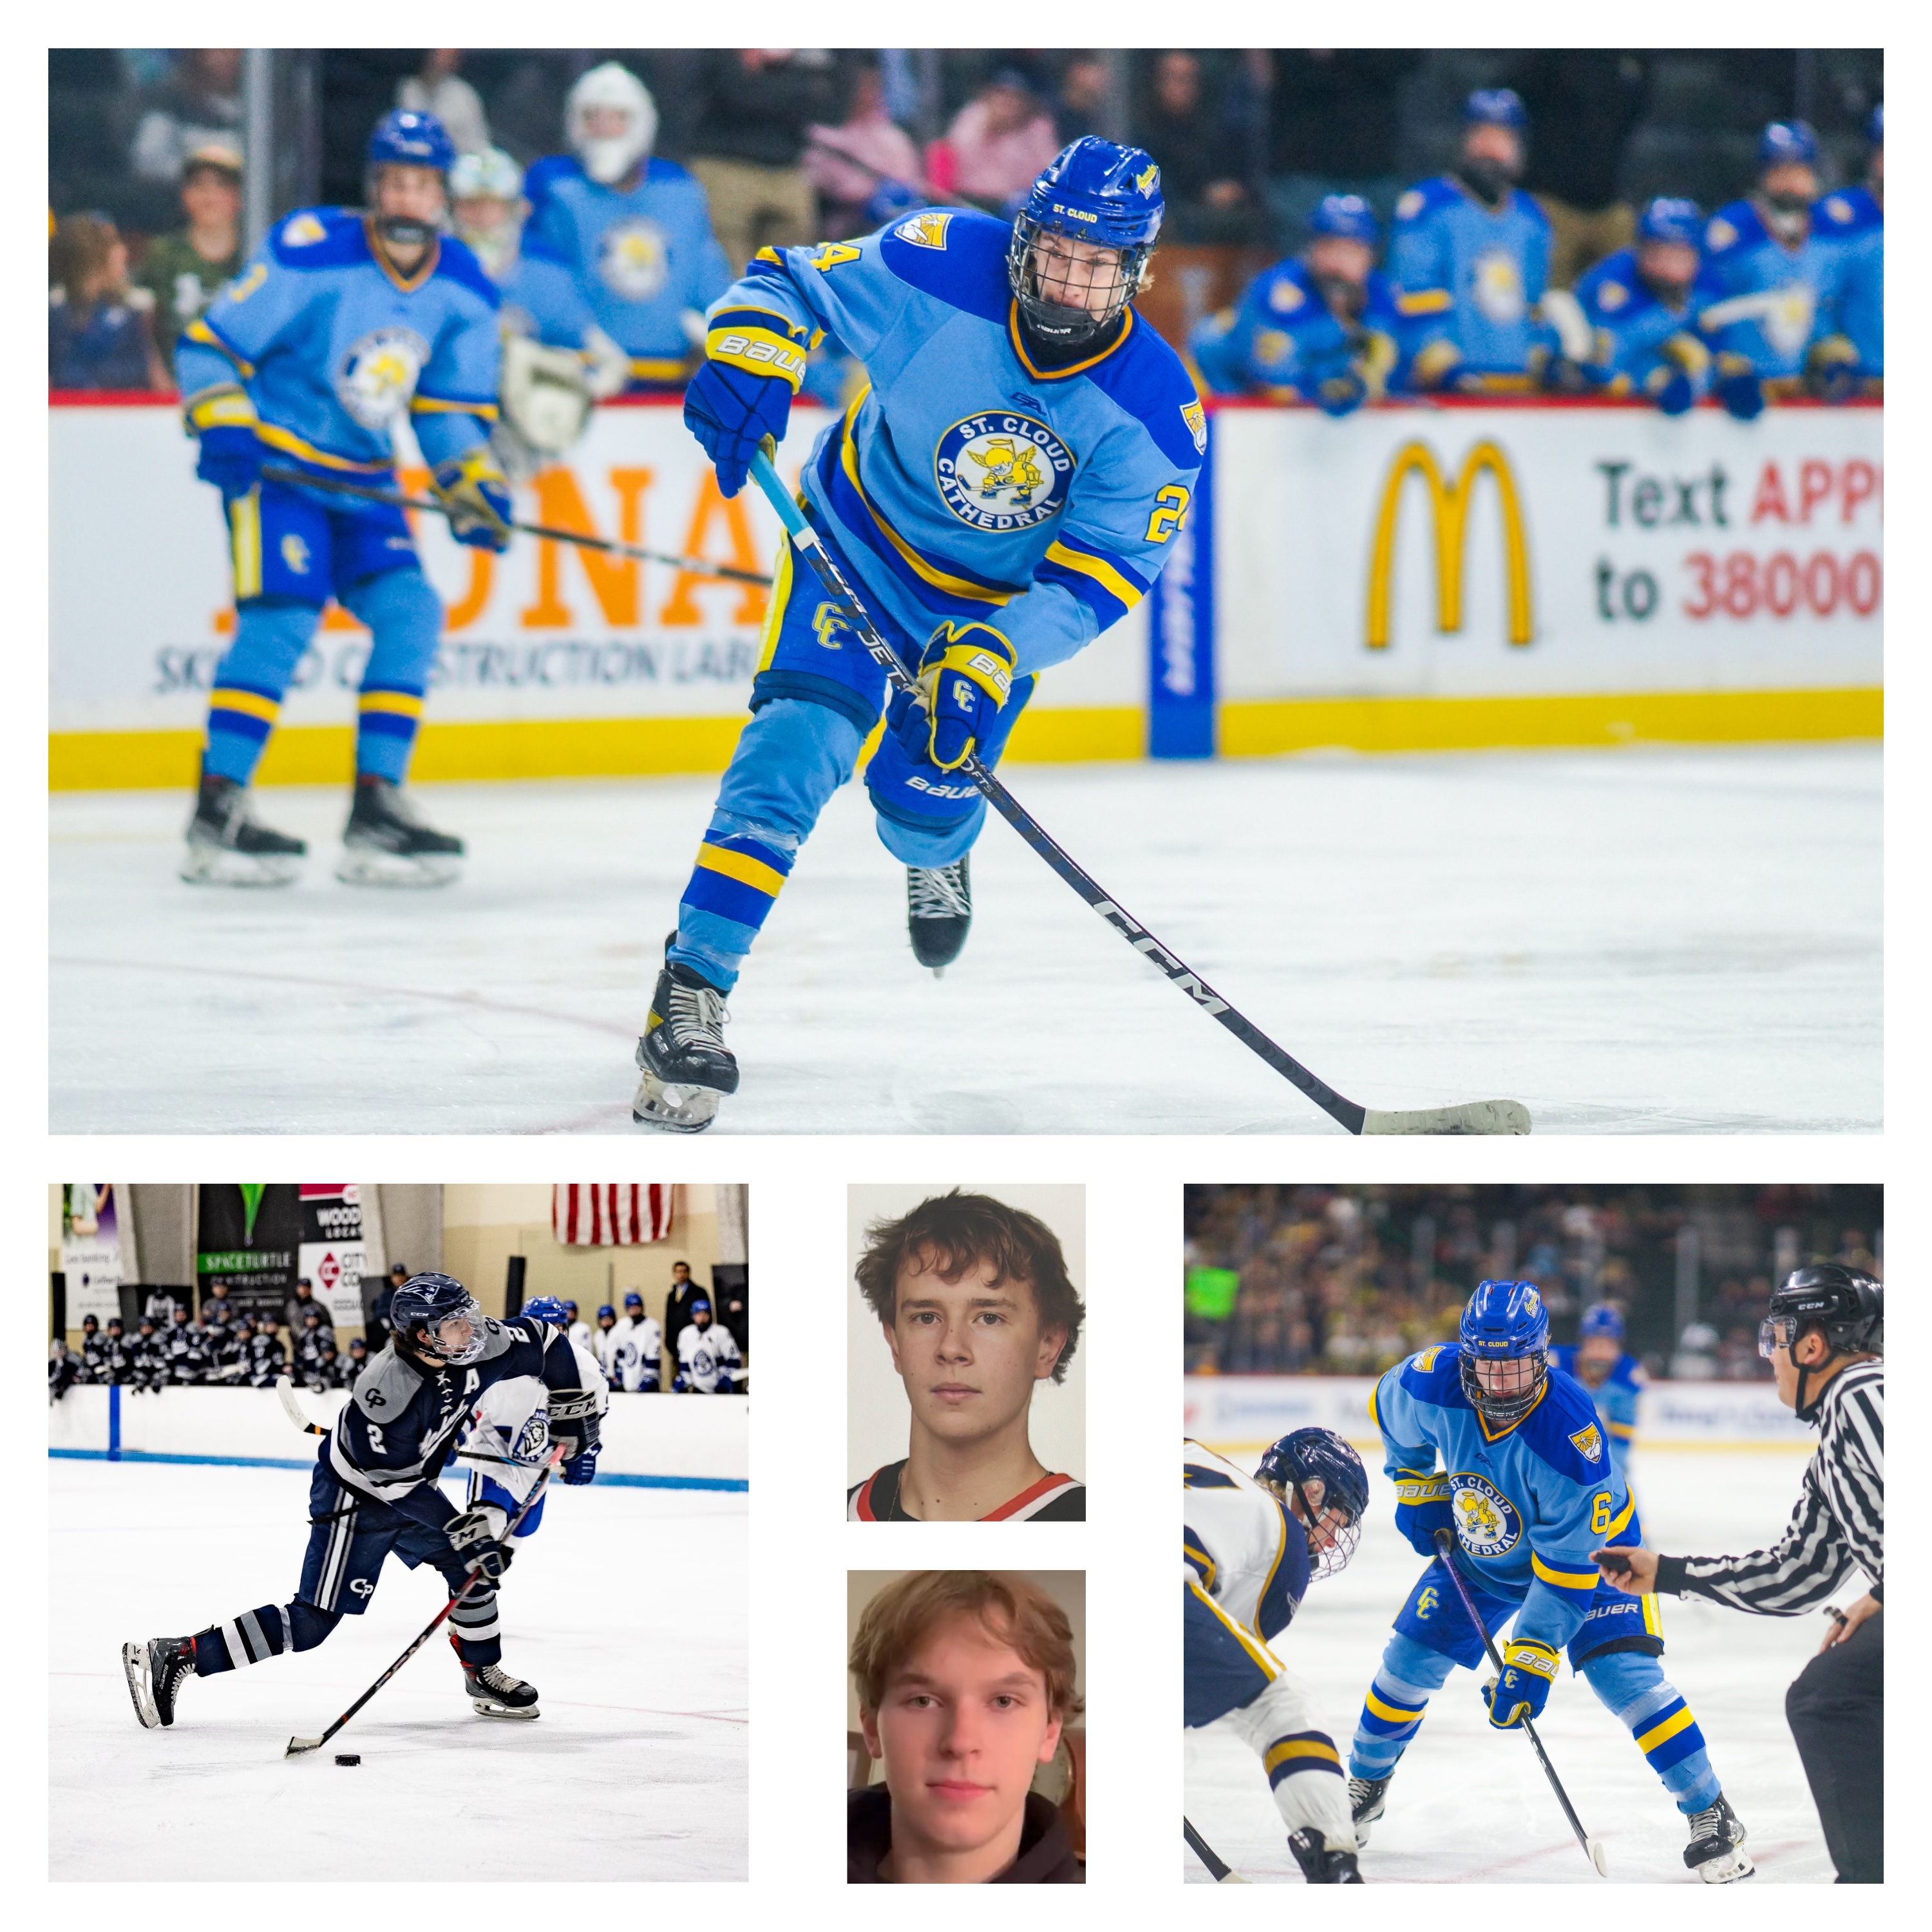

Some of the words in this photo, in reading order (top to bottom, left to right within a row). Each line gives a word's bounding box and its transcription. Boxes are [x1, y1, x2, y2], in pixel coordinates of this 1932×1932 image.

[1052, 203, 1065, 215] ST.
[1066, 207, 1098, 223] CLOUD
[959, 417, 994, 439] ST.
[1003, 417, 1070, 471] CLOUD
[938, 457, 1064, 529] CATHEDRAL
[1145, 482, 1191, 544] 2
[1595, 460, 1728, 527] Text
[1748, 459, 1884, 524] APP
[1595, 555, 1660, 621] to
[1681, 551, 1883, 620] 38000
[1093, 900, 1230, 1016] CCM
[1797, 1302, 1825, 1311] CCM
[463, 1367, 480, 1396] A
[547, 1399, 596, 1417] CCM
[366, 1423, 388, 1455] 2
[1450, 1477, 1464, 1491] ST.
[1467, 1476, 1513, 1514] CLOUD
[1589, 1492, 1612, 1535] 6
